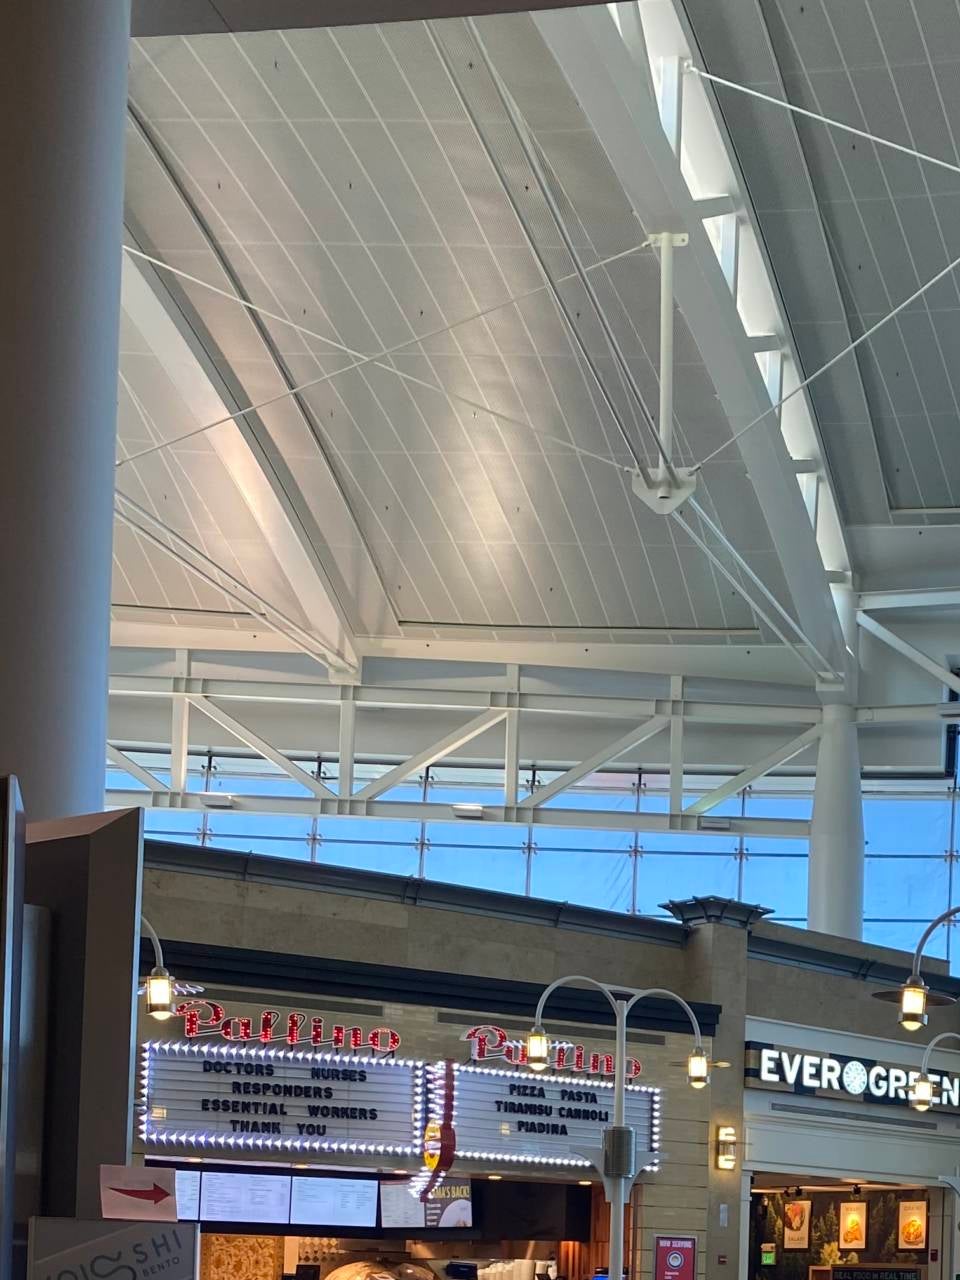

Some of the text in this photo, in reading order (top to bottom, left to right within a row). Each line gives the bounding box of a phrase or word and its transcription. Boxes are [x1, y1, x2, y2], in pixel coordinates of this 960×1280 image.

[174, 1000, 401, 1051] Pallino
[460, 1025, 643, 1078] Palino
[203, 1060, 367, 1082] DOCTORS NURSES
[232, 1082, 333, 1099] RESPONDERS
[509, 1084, 598, 1104] PIZZA PASTA
[201, 1099, 378, 1120] ESSENTIAL WORKERS
[495, 1100, 609, 1122] TIRAMISU CANNOLI
[230, 1119, 327, 1136] THANK YOU
[517, 1120, 568, 1136] PIADINA
[142, 1256, 180, 1277] BENTO
[880, 1272, 898, 1280] REAL
[899, 1272, 917, 1280] TIME
